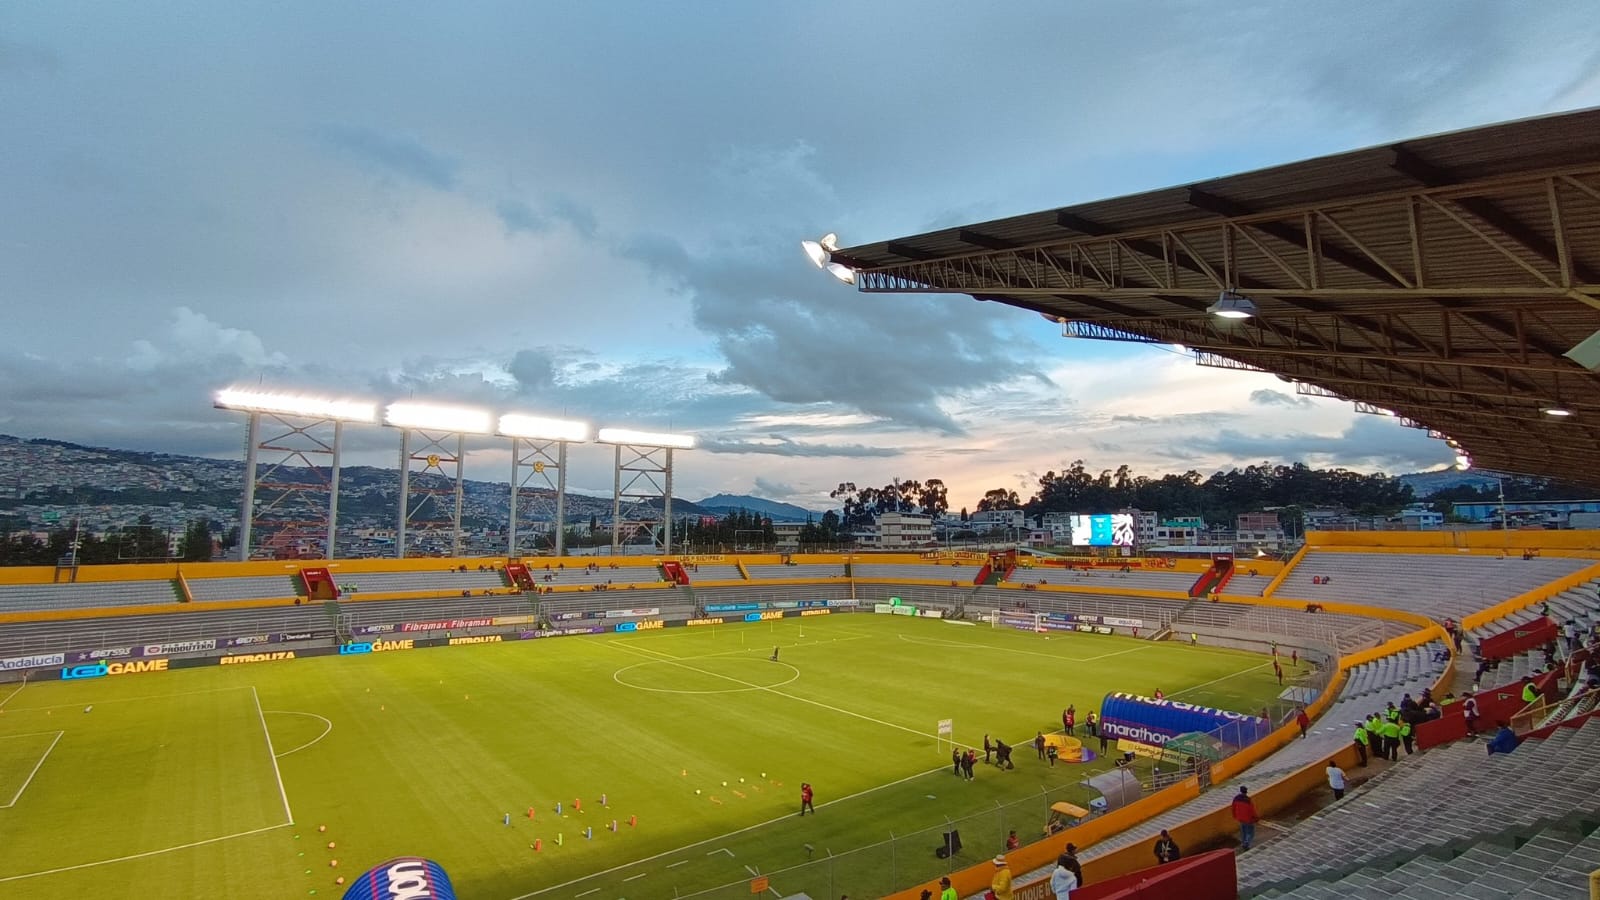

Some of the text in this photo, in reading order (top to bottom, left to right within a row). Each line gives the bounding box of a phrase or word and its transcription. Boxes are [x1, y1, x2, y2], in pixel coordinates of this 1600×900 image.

[405, 622, 448, 632] Fibramax
[451, 619, 491, 629] Fibramax
[1103, 721, 1172, 745] marathon
